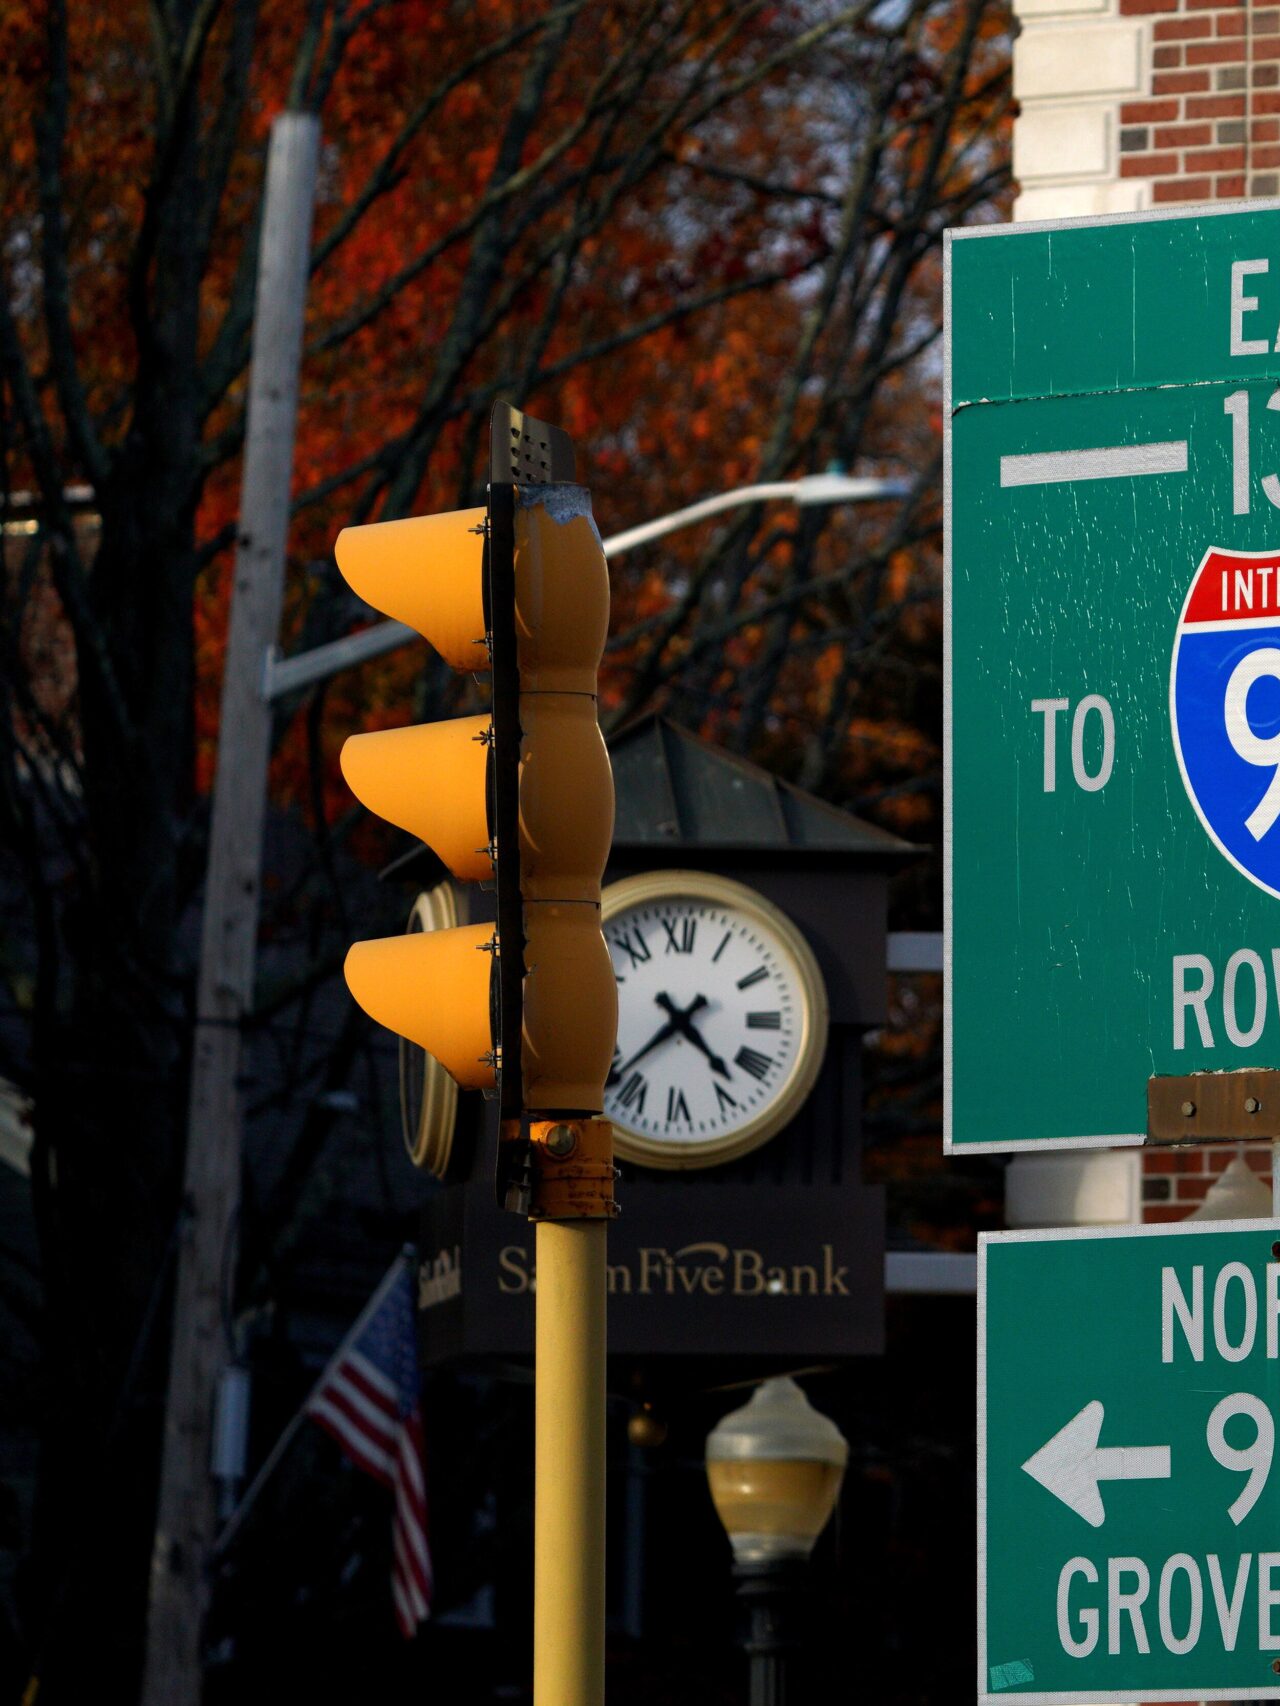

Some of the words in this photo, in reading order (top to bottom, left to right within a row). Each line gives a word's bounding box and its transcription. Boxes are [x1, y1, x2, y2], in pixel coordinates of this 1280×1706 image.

[1031, 693, 1116, 793] TO
[639, 1242, 728, 1296] Five
[732, 1244, 850, 1296] Bank
